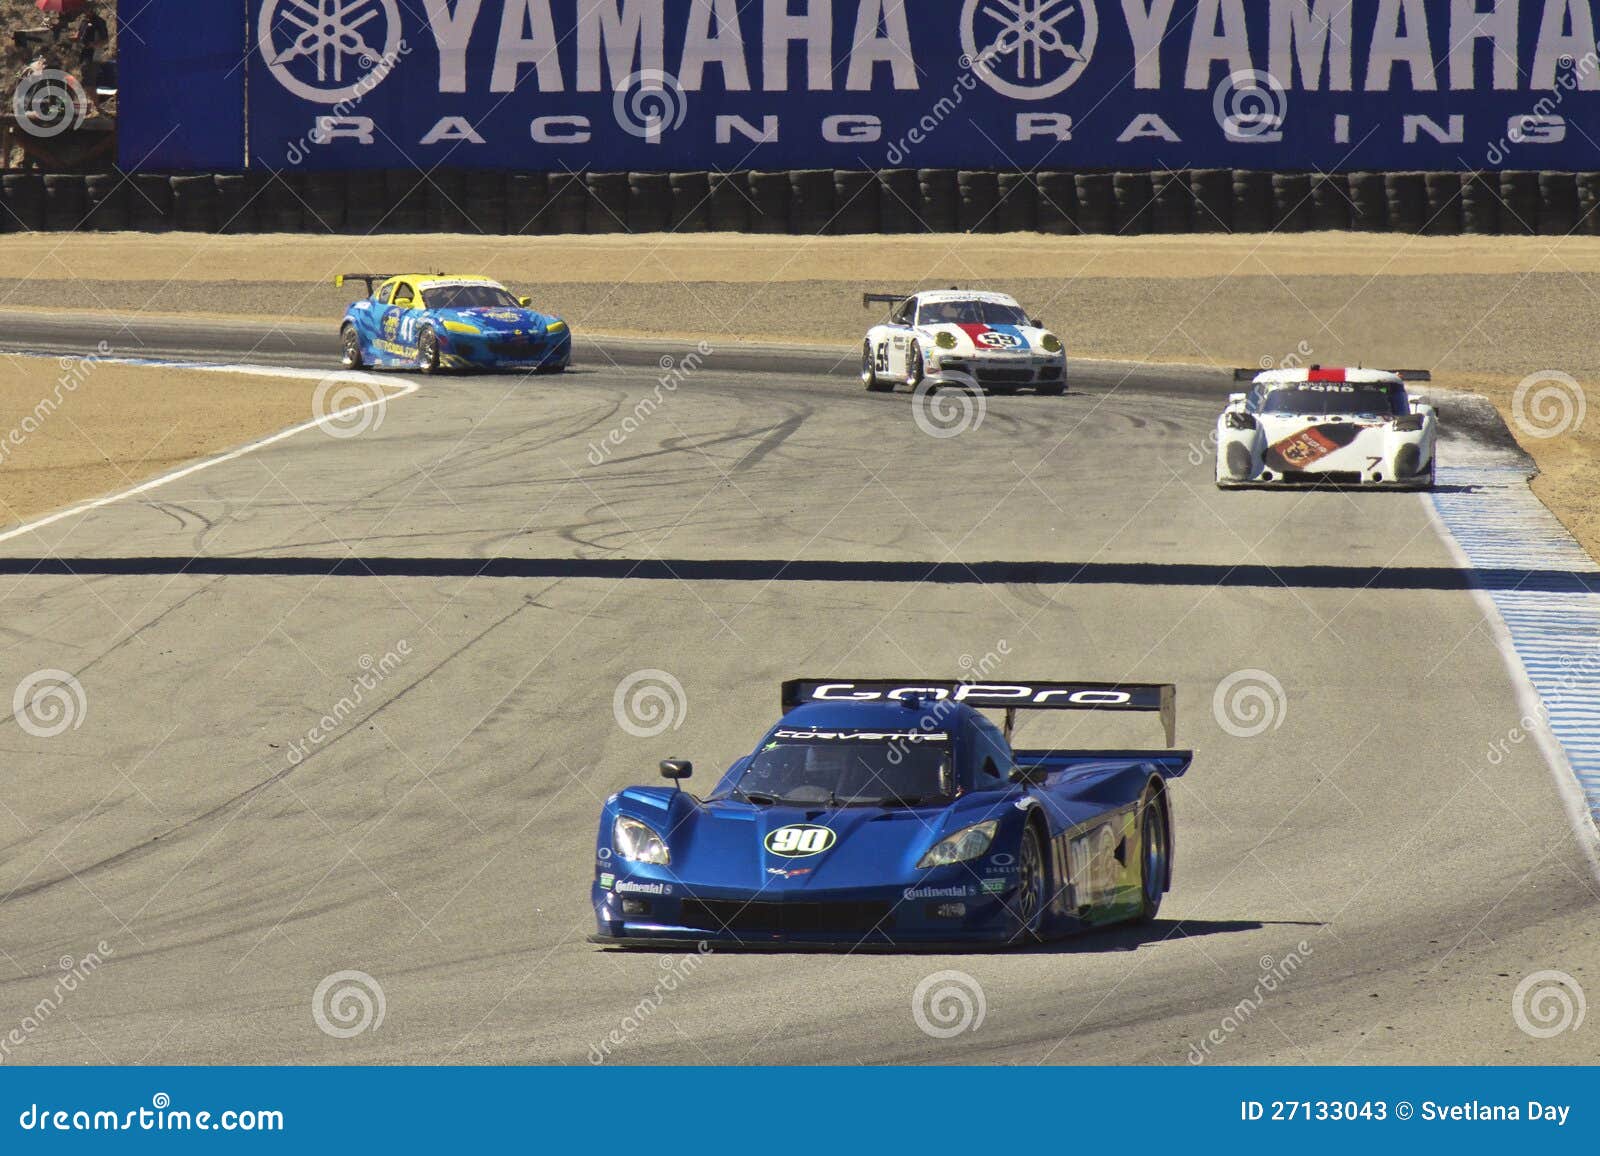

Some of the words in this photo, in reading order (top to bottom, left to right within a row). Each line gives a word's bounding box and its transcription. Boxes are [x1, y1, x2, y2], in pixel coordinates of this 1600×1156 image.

[417, 0, 920, 92] YAMAHA
[1119, 0, 1600, 91] YAMAHA
[315, 114, 882, 145] RACING
[1015, 112, 1567, 144] RACING
[1366, 456, 1382, 471] 7
[812, 684, 1131, 705] GoPro
[772, 828, 828, 852] 90
[615, 880, 664, 895] Continental
[903, 885, 966, 901] Continental
